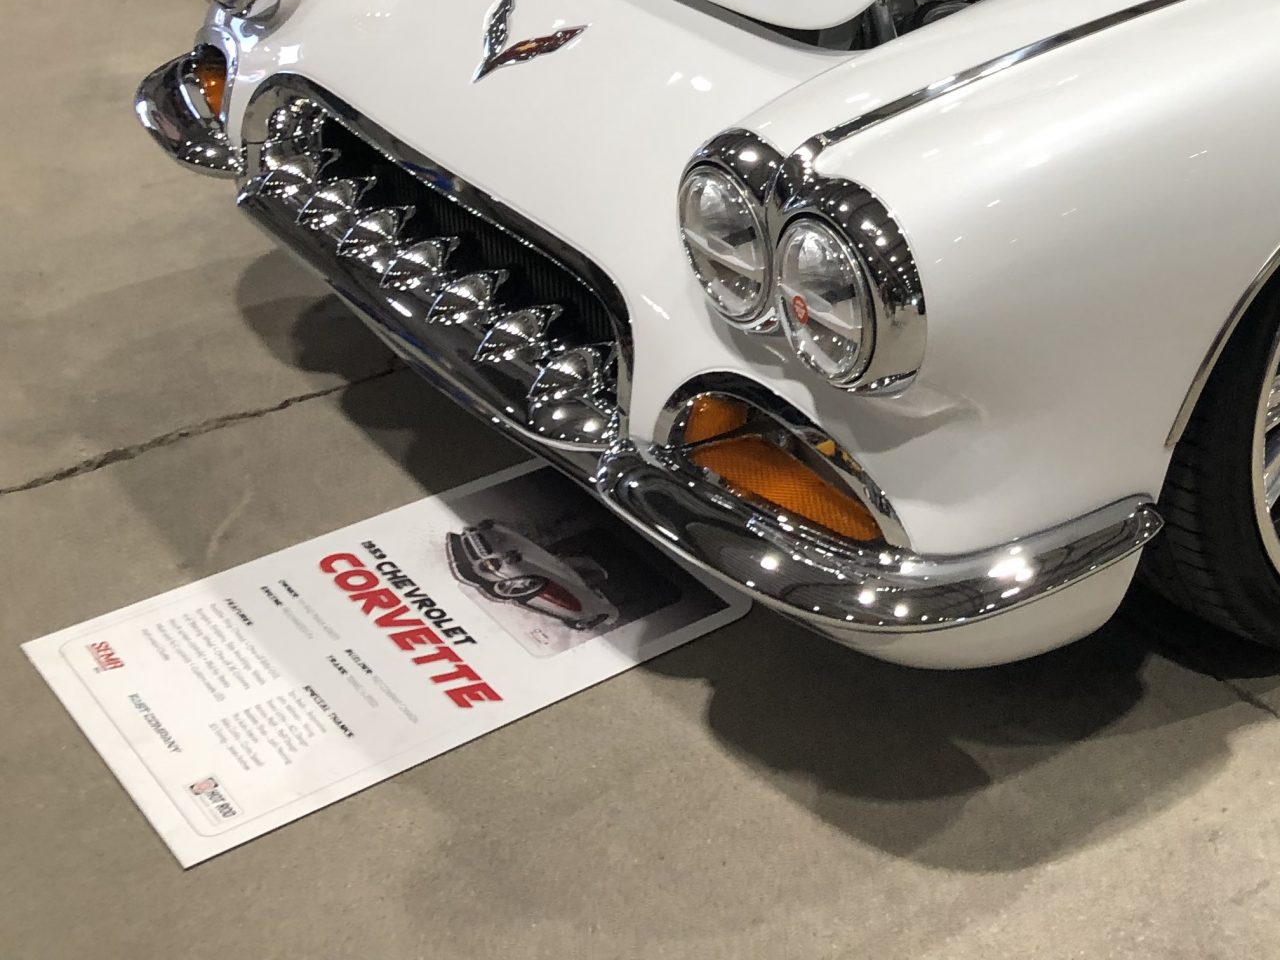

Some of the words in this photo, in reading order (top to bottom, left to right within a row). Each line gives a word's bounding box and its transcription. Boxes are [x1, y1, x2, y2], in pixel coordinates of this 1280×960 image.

[361, 541, 387, 559] 1959
[375, 561, 476, 646] CHEVROLET
[319, 553, 503, 708] CORVETTE
[90, 641, 125, 670] SEMA
[144, 713, 182, 752] COMPANY
[207, 789, 225, 803] HOT
[216, 803, 236, 818] ROD
